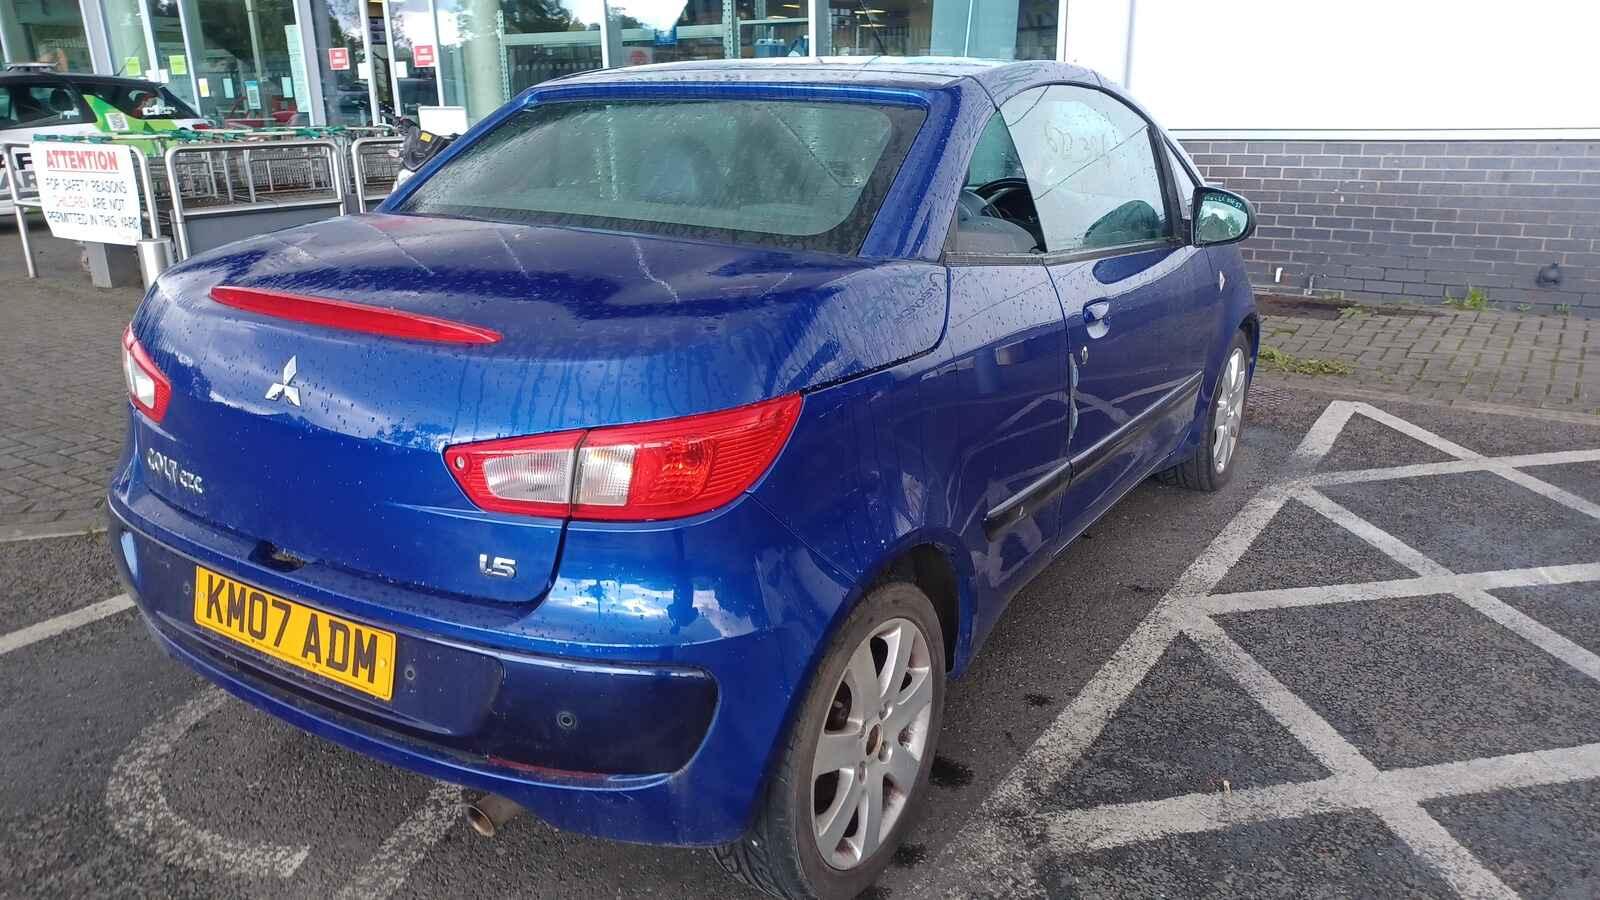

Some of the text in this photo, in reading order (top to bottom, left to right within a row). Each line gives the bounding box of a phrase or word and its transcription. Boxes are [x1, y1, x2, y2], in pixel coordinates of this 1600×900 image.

[45, 149, 119, 171] ATTENTION
[45, 177, 128, 194] FOR SAFETY REASONS
[53, 193, 125, 212] CHILDREN ARE NOT
[46, 210, 139, 230] PERMITTED IN THIS YARD
[146, 447, 178, 488] COLT
[479, 553, 517, 577] 1.5
[205, 573, 378, 685] KM07 ADM
